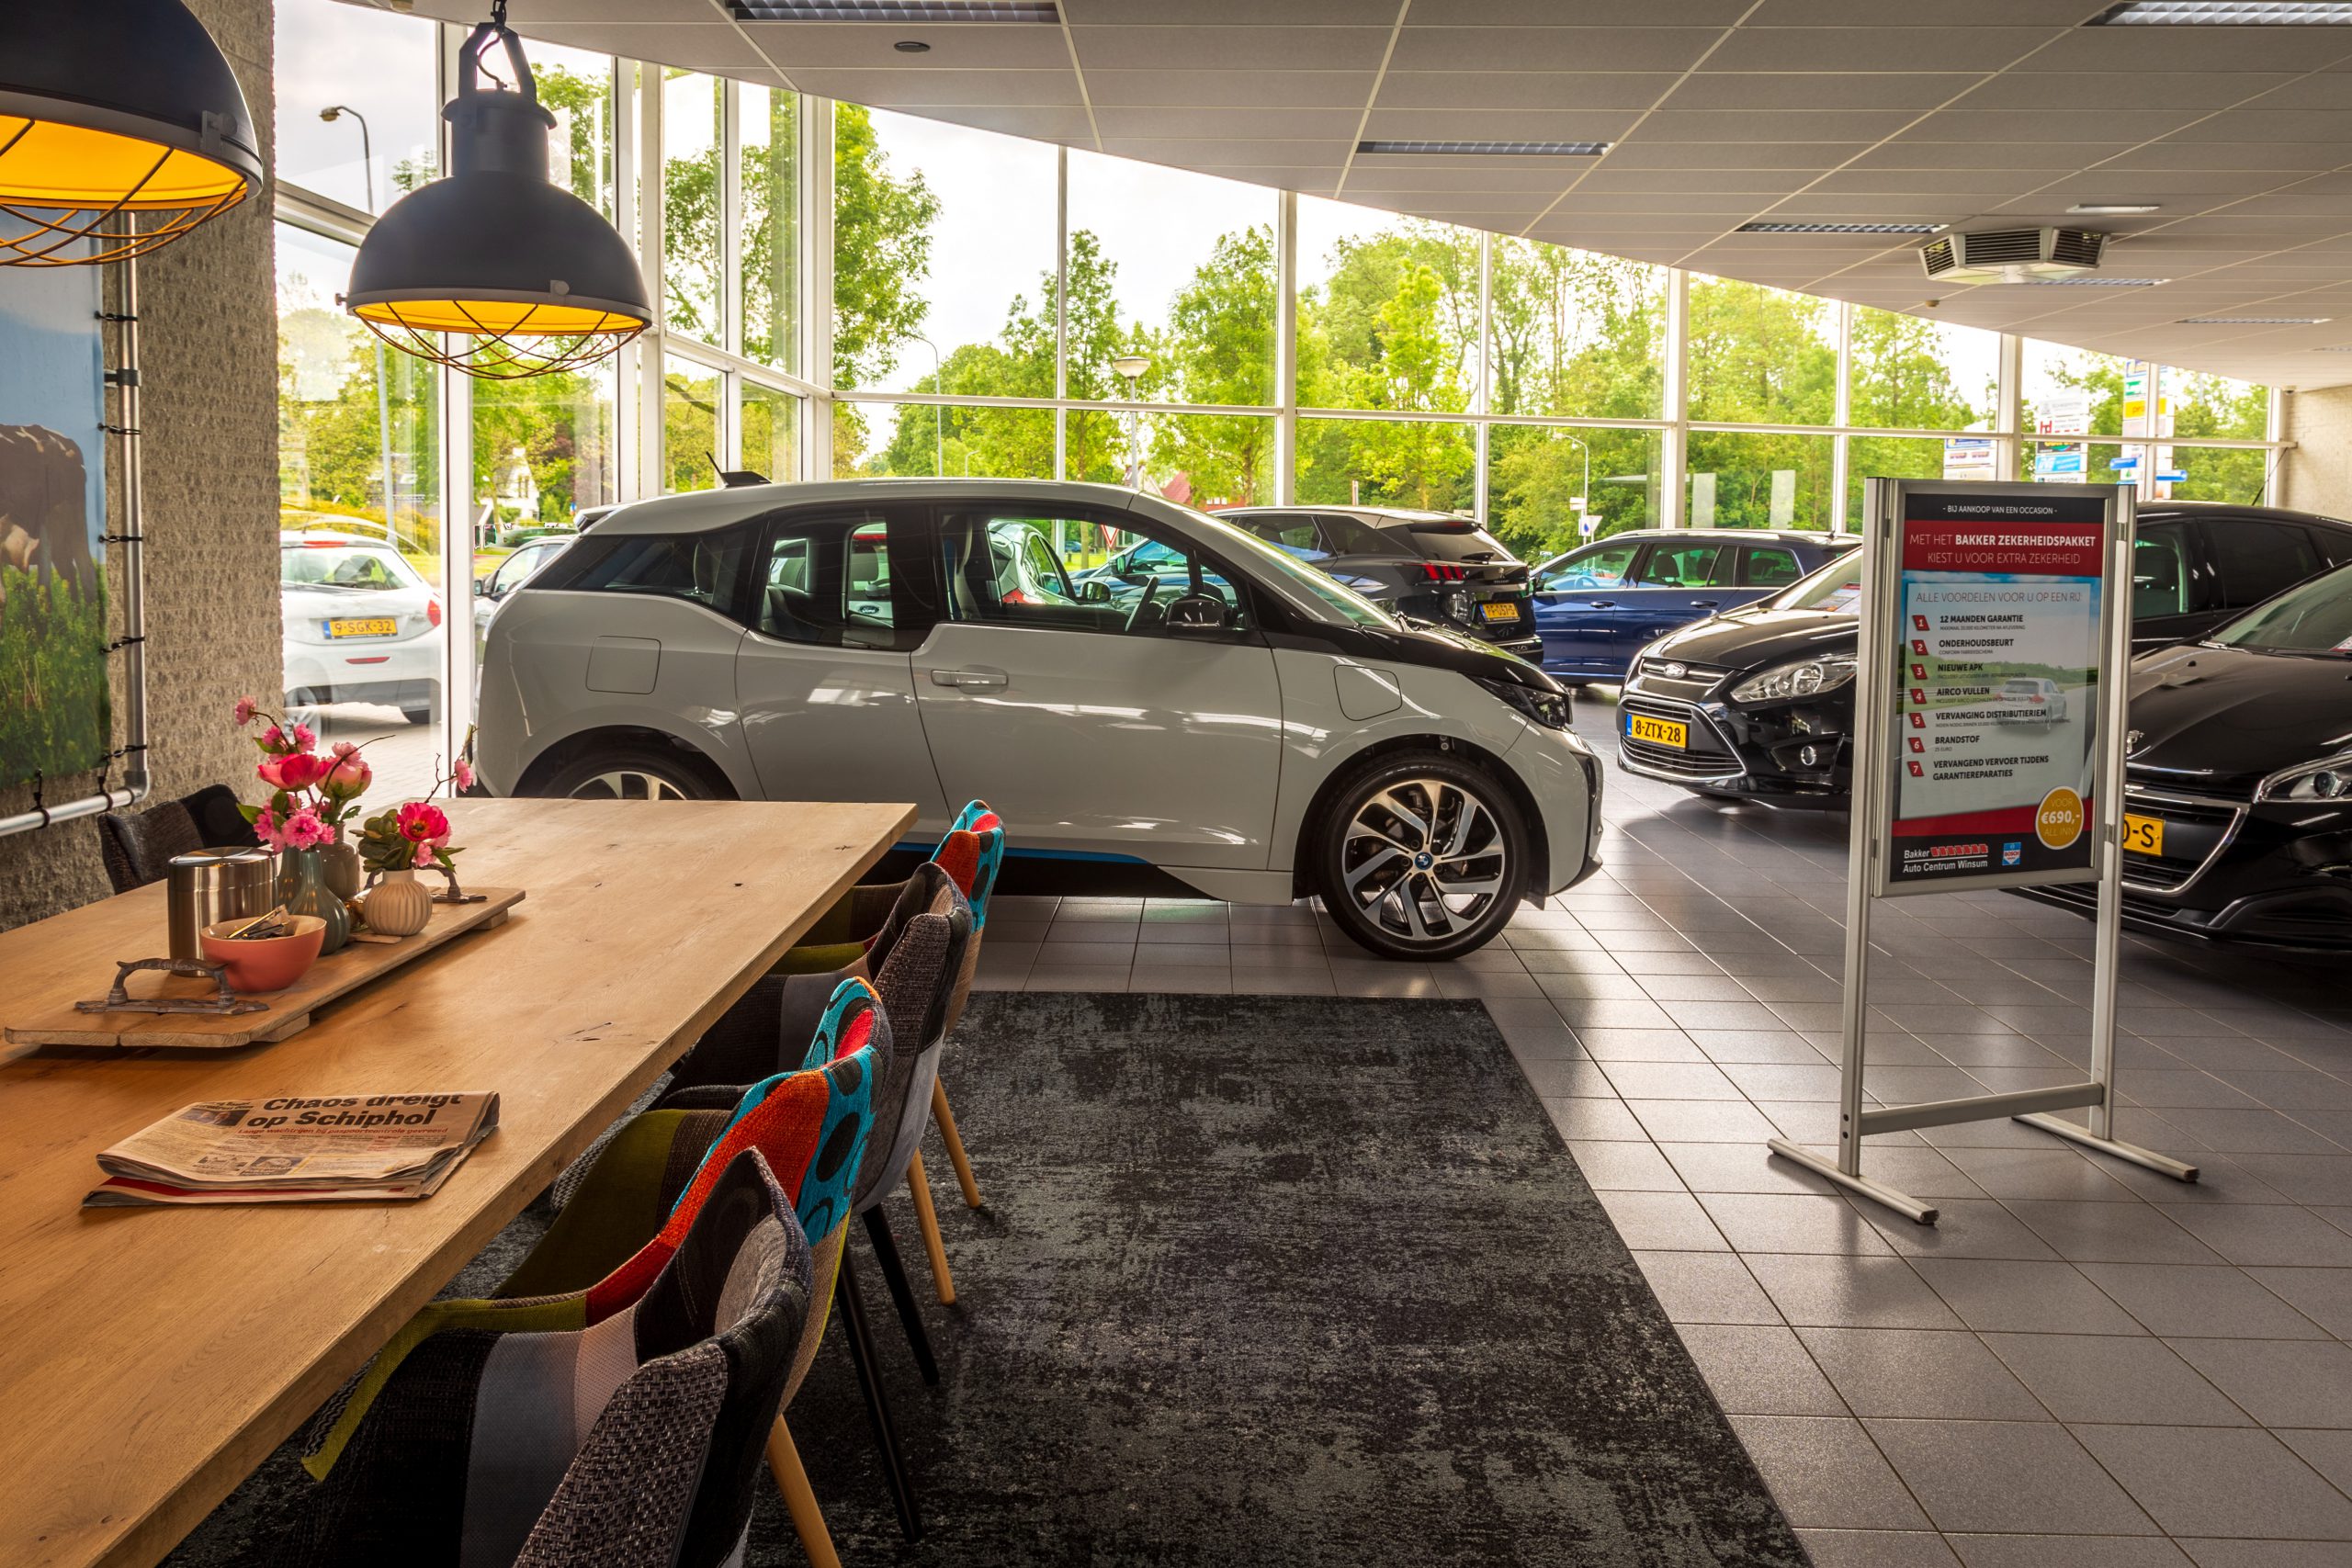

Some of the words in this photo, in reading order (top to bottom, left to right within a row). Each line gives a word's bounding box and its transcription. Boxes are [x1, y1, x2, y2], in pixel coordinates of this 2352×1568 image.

[1947, 505, 1958, 513] BIJ
[1959, 505, 1991, 513] AANKOOP
[2006, 506, 2018, 514] EEN
[1909, 534, 1931, 546] MET
[1933, 535, 1953, 546] HET
[1955, 535, 1996, 547] BAKKER
[1997, 535, 2096, 547] ZEKERHEIDSPAKKET
[1928, 552, 1953, 563] KIEST
[1955, 553, 1962, 563] U
[1964, 553, 1995, 564] VOOR
[1996, 553, 2027, 564] EXTRA
[2029, 553, 2081, 565] ZEKERHEID
[1916, 592, 1940, 603] ALLE
[1941, 592, 1996, 603] VOORDELEN
[1997, 592, 2026, 603] VOOR
[2027, 592, 2035, 602] U
[2036, 592, 2049, 602] OP
[2051, 592, 2068, 602] EEN
[1918, 618, 1924, 626] 1
[1951, 615, 1985, 623] MAANDEN
[1987, 615, 2023, 623] GARANTIE
[334, 620, 393, 634] 9-SGK-32
[1939, 638, 2014, 648] ONDERHOUDSBEURT
[1917, 644, 1923, 652] 2
[1917, 667, 1922, 675] 3
[1938, 663, 1968, 671] NIEUWE
[1937, 688, 1962, 696] AIRCO
[1962, 687, 1990, 695] VULLEN
[1916, 692, 1921, 701] 4
[1936, 711, 1984, 720] VERVANGING
[1986, 709, 2047, 719] DISTRIBUTIERIEM
[1915, 716, 1920, 725] 5
[1635, 719, 1681, 743] 8-ZTX-28
[1935, 735, 1980, 744] BRANDSTOF
[1914, 740, 1920, 749] 6
[1933, 759, 1984, 768] VERVANGEND
[1985, 757, 2018, 766] VERVOER
[2020, 755, 2049, 764] TIJDENS
[1913, 765, 1918, 773] 7
[1933, 769, 2013, 781] GARANTIEREPARATIES
[2051, 797, 2074, 807] VOOR
[2041, 810, 2080, 825] €690,-
[2044, 828, 2058, 837] ALL
[1904, 850, 1930, 859] Bakker
[1903, 863, 1921, 873] Auto
[1923, 862, 1956, 872] Centrum
[1957, 860, 1988, 869] Winsum
[263, 1098, 359, 1111] Chaos
[366, 1094, 464, 1109] dreigt
[247, 1116, 288, 1129] op
[295, 1109, 437, 1129] Schiphol
[328, 1127, 405, 1135] paspoortcontrole
